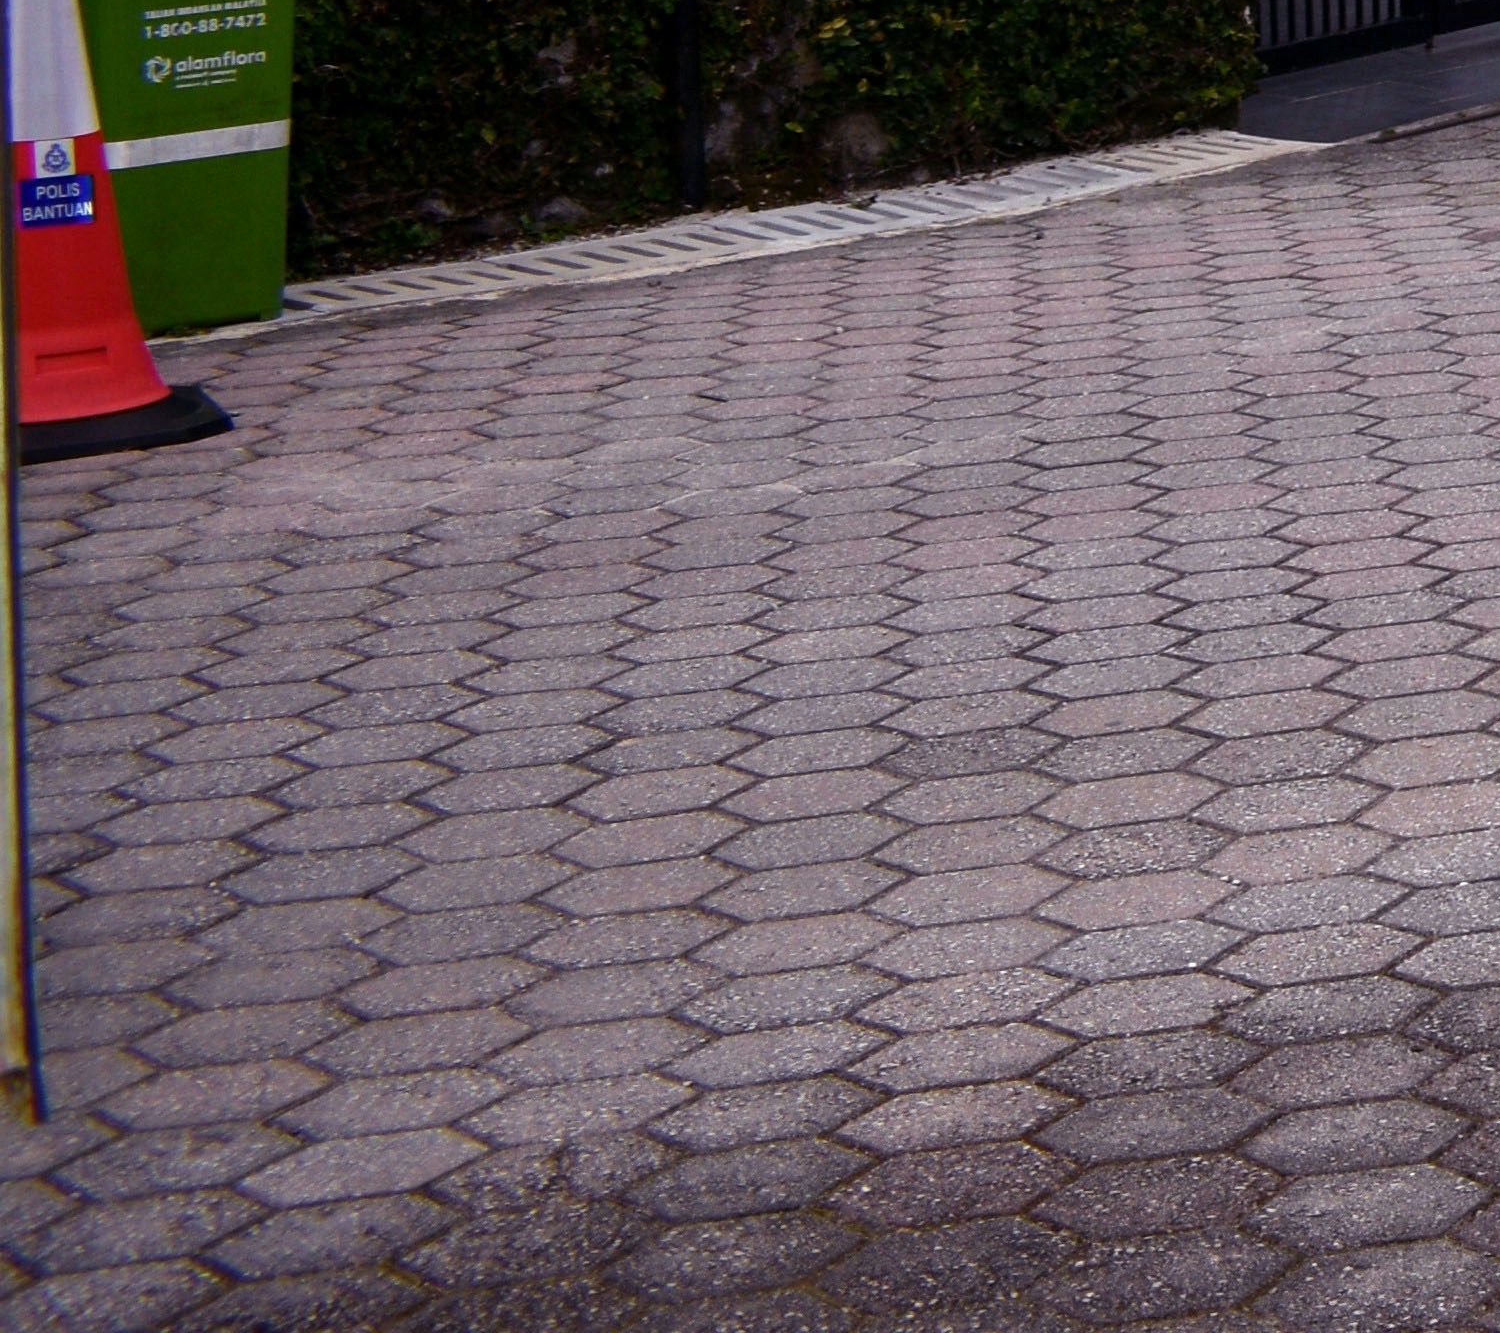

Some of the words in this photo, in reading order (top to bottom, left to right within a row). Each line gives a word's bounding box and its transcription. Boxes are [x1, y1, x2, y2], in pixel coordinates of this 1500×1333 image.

[144, 13, 267, 39] 1-800-88-7472
[176, 50, 266, 73] alamflora
[36, 183, 80, 200] POLIS
[22, 201, 93, 222] BANTUAN
